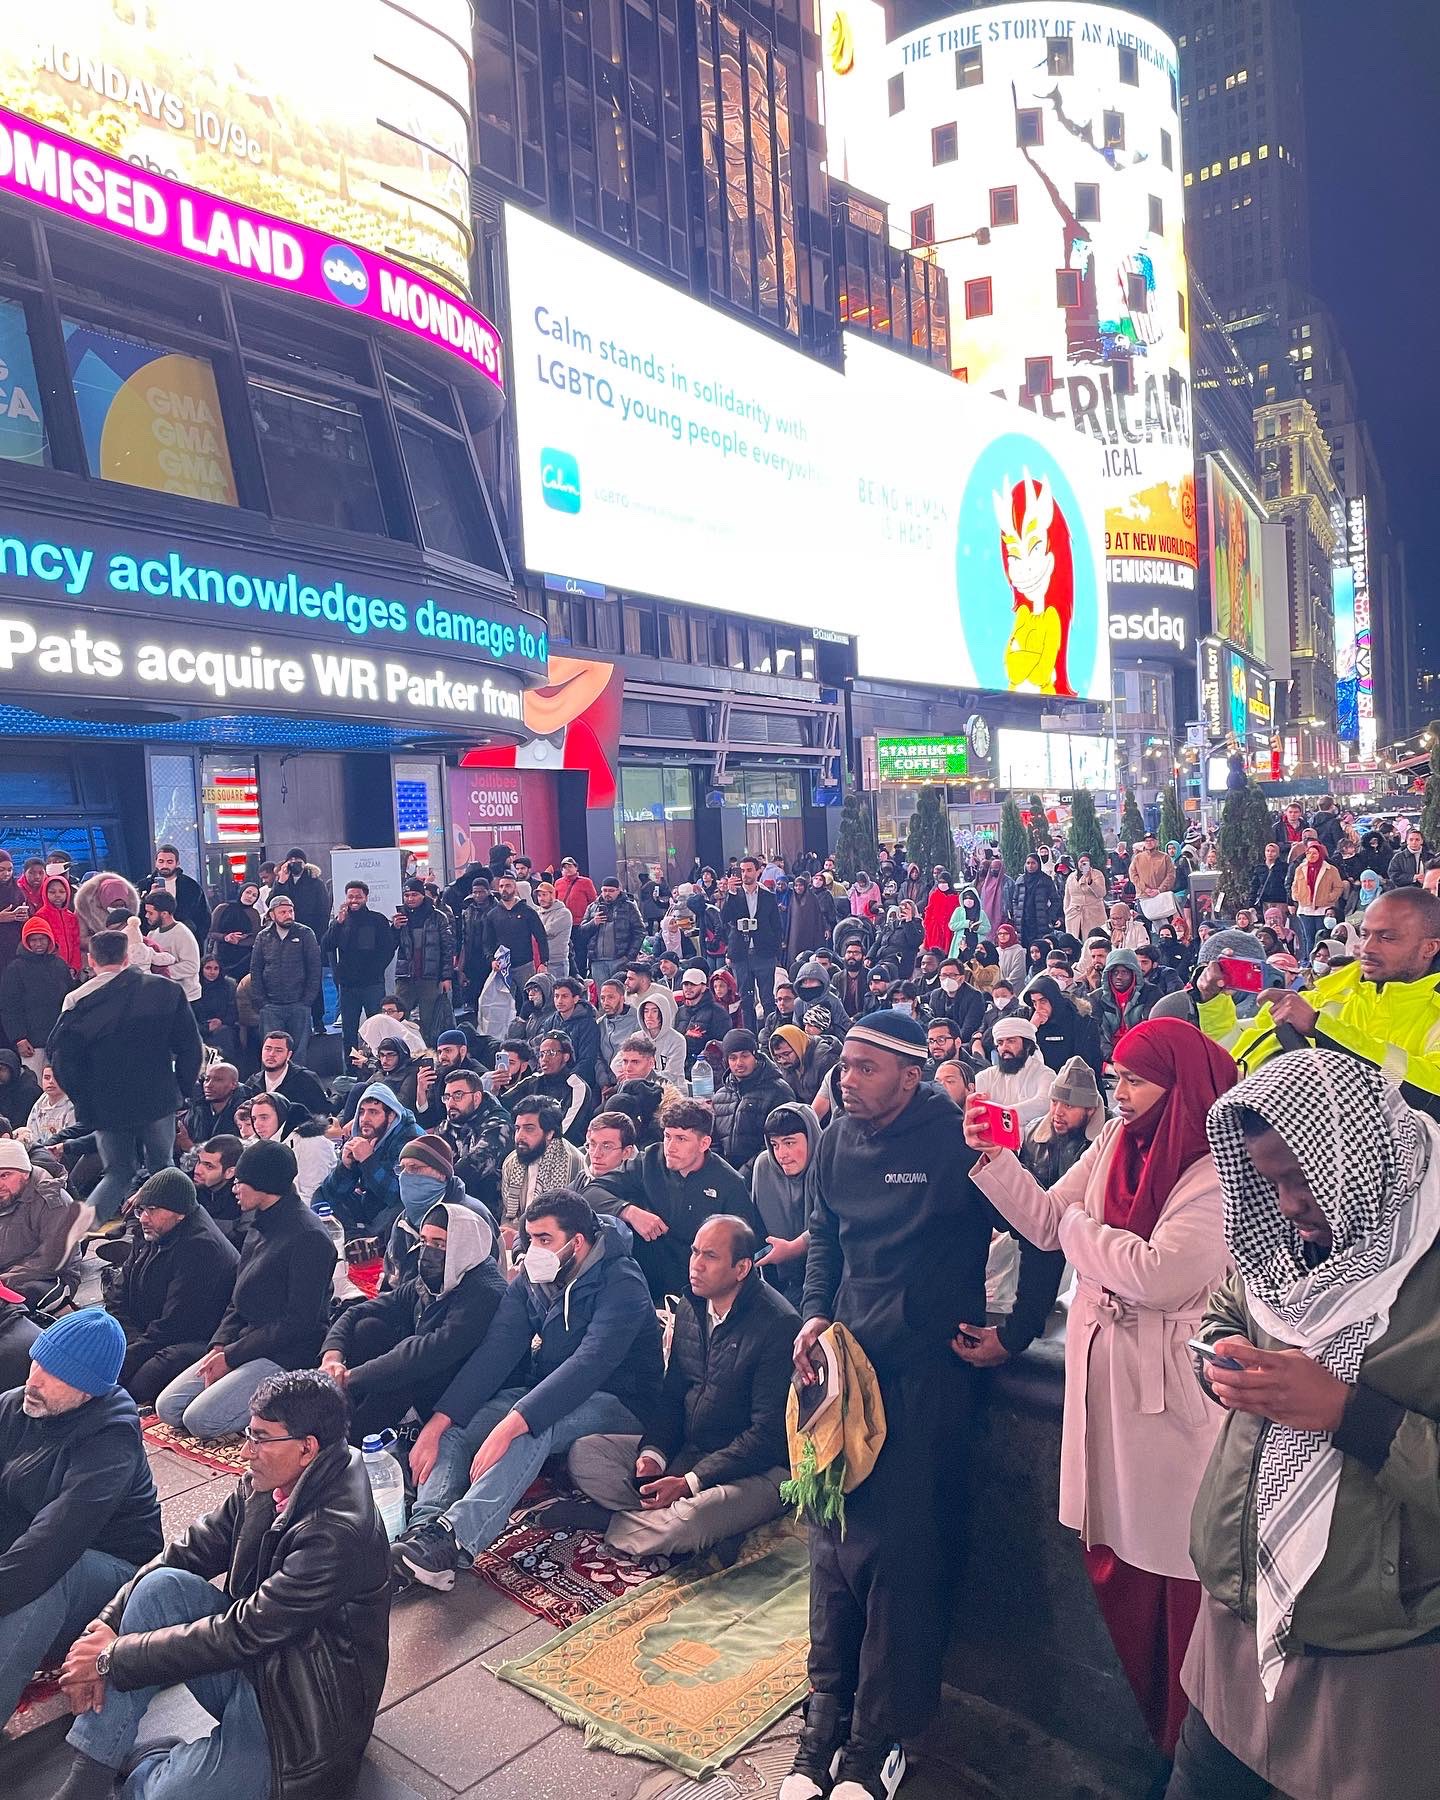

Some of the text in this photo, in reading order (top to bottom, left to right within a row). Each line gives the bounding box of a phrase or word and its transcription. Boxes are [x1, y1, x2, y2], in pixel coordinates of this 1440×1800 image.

[902, 37, 932, 65] THE
[938, 24, 983, 53] TRUE
[988, 19, 1048, 42] STORY
[1054, 20, 1076, 39] OF
[1081, 22, 1101, 44] AN
[192, 107, 262, 164] 10/9c
[180, 198, 305, 281] LAND
[323, 259, 367, 290] abc
[379, 268, 496, 373] MONDAYS
[534, 306, 808, 441] Calm stands in solidarity with
[146, 386, 217, 427] GMA
[537, 354, 615, 408] LGBTQ
[620, 394, 682, 441] young
[688, 420, 748, 457] people
[152, 417, 223, 457] GMA
[158, 449, 228, 488] GMA
[1102, 447, 1142, 478] ICAL
[1115, 532, 1130, 550] AT
[1133, 532, 1157, 551] NEW
[1158, 535, 1184, 556] WORLD
[108, 552, 407, 635] acknowledges
[415, 599, 515, 658] damage
[518, 624, 535, 658] to
[1109, 607, 1185, 651] asdaq
[0, 619, 123, 677] Pats
[137, 646, 305, 697] acquire
[311, 653, 379, 701] WR
[385, 662, 478, 713] Parker
[880, 745, 966, 757] STARBUCKS
[217, 789, 243, 801] SQUARE
[471, 771, 517, 788] Jollibee
[471, 790, 519, 804] COMING
[479, 803, 514, 817] SOON
[884, 1173, 928, 1184] OKUNZUWA
